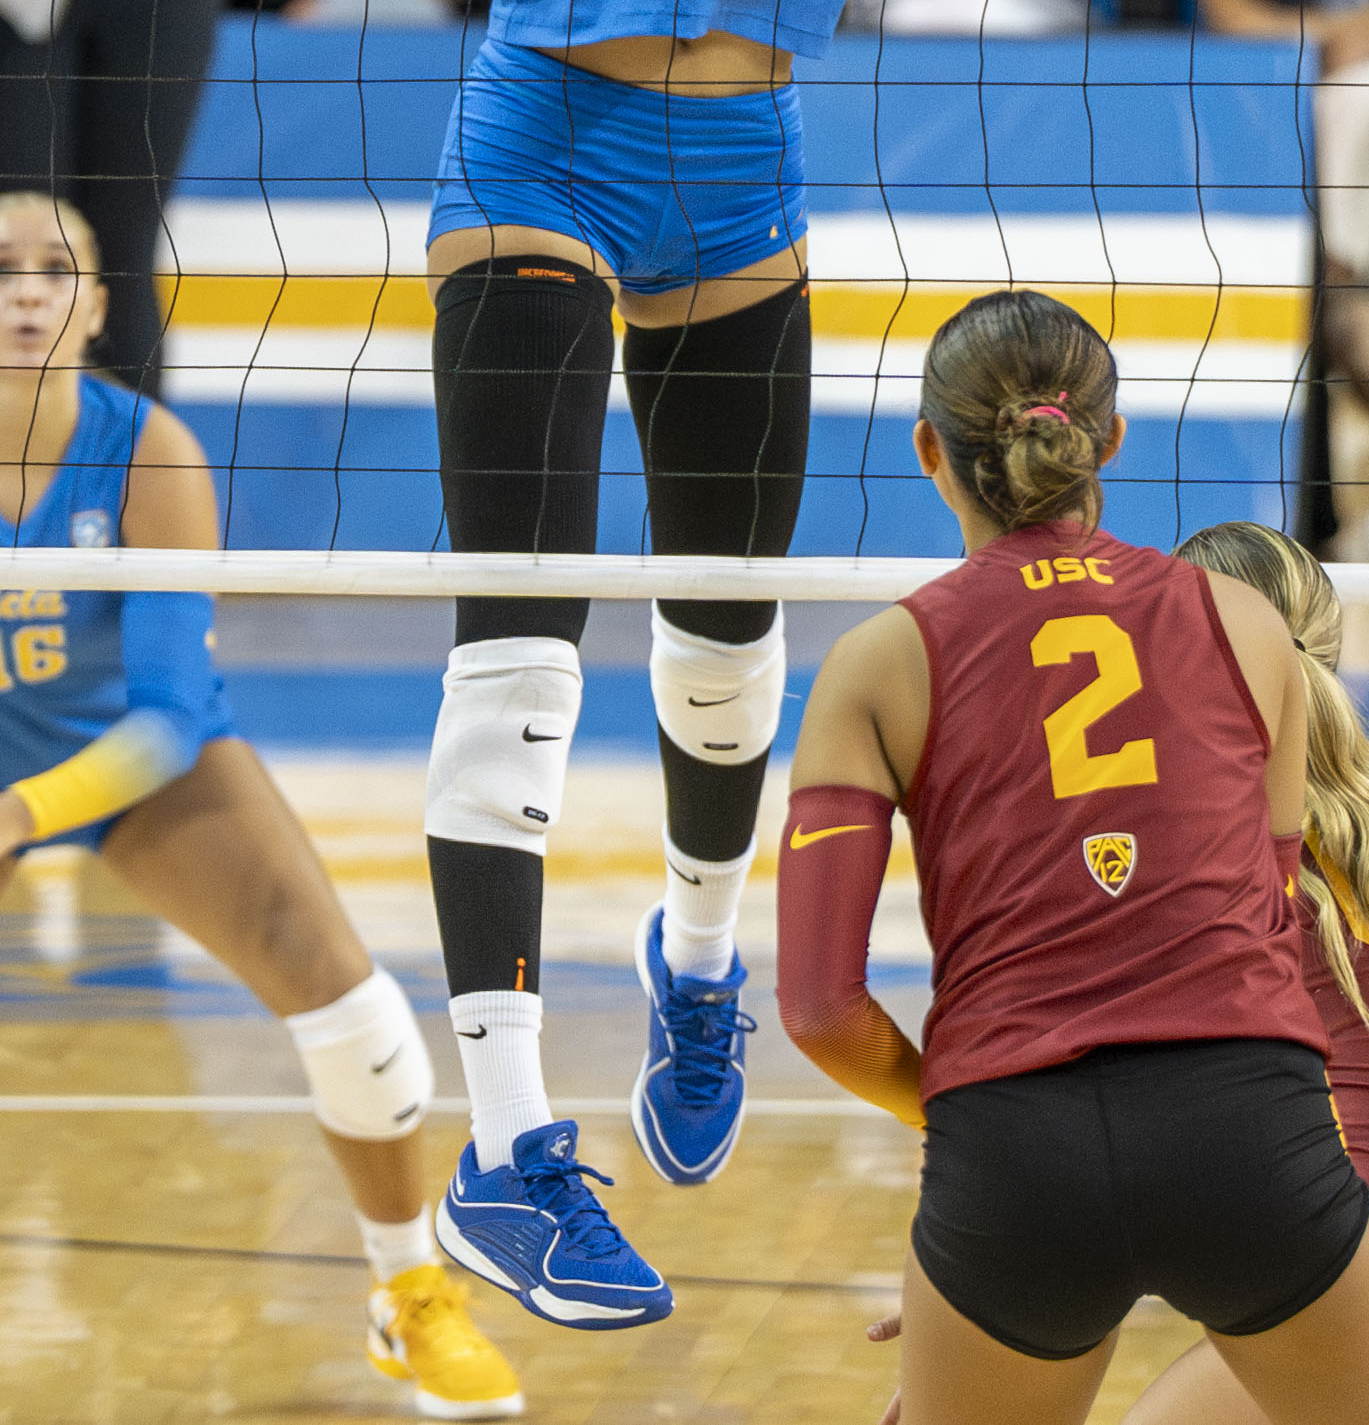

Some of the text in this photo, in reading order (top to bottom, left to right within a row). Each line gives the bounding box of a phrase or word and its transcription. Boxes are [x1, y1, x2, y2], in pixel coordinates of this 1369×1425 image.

[1019, 557, 1115, 591] USC
[1030, 614, 1159, 800] 2
[1086, 837, 1132, 874] PAC
[1100, 859, 1125, 884] 12
